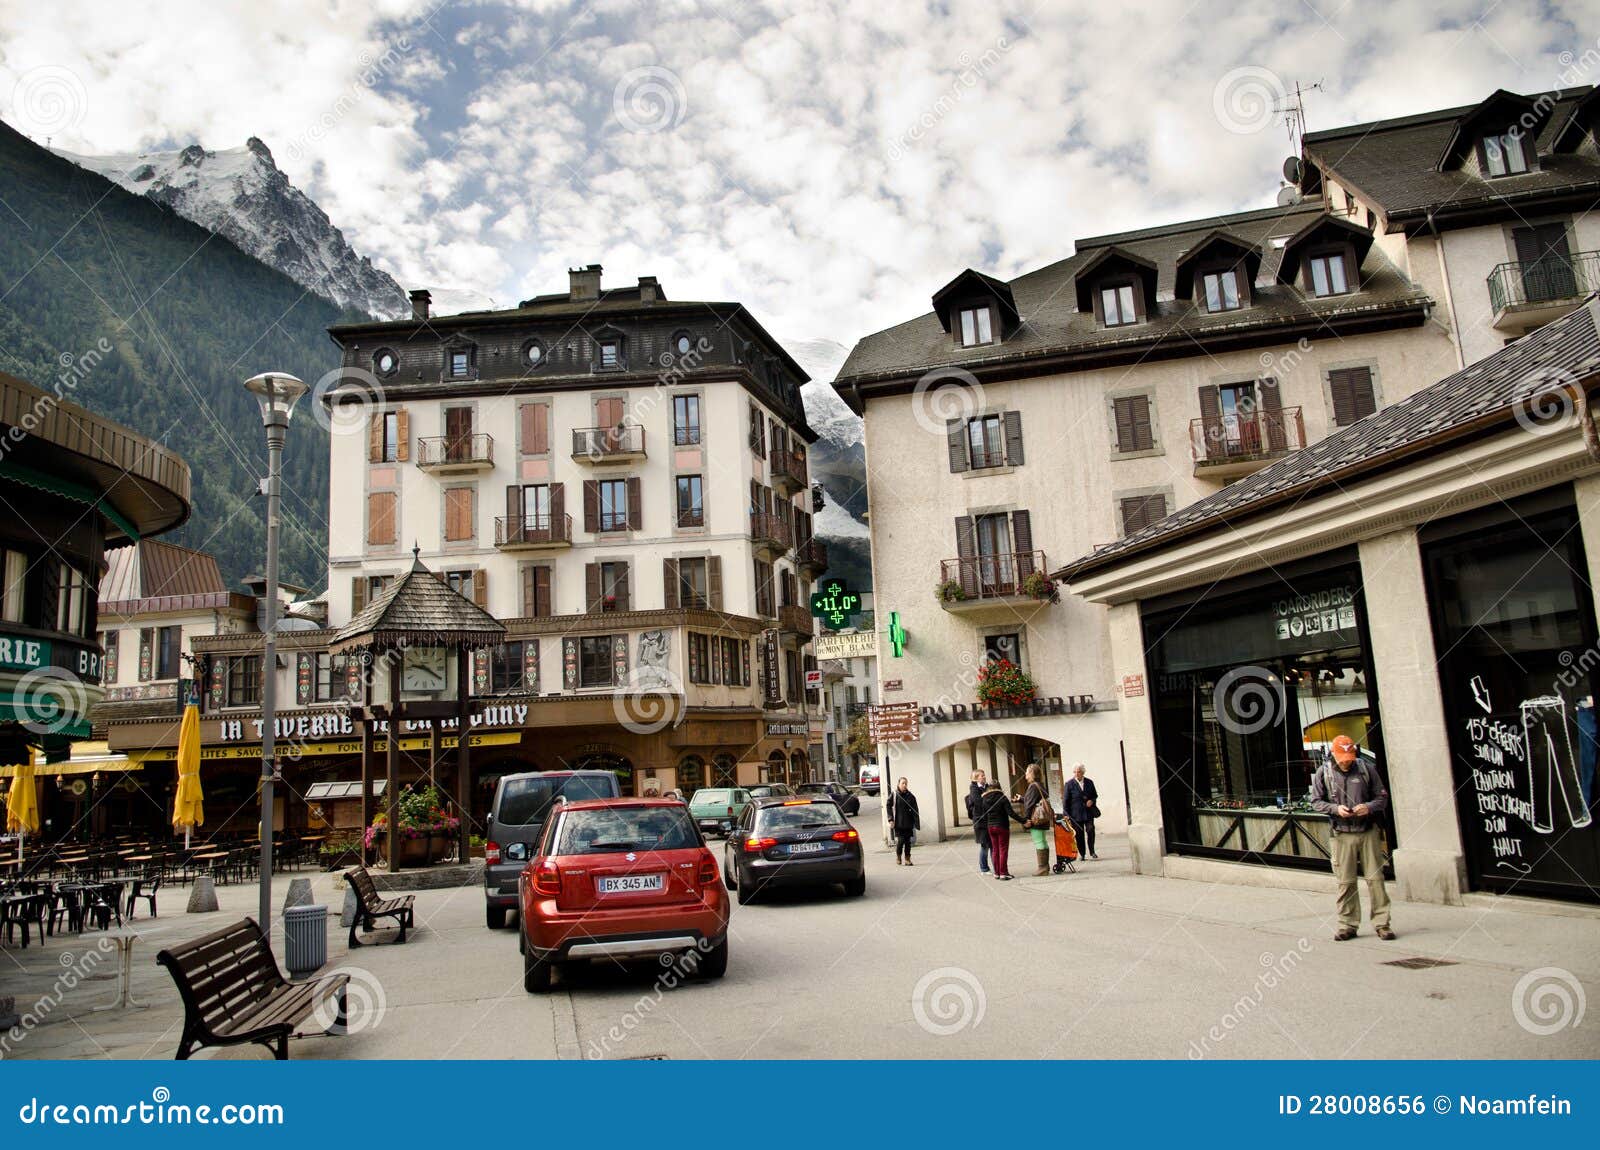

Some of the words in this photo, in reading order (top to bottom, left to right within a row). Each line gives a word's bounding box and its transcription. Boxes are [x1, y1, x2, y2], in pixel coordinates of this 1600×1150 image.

[1272, 585, 1353, 617] BOARDRIDERS
[816, 633, 876, 647] PARFUMERIE
[1492, 837, 1523, 858] HAUT
[606, 879, 620, 891] BX
[622, 878, 642, 891] 345
[643, 876, 657, 889] AN
